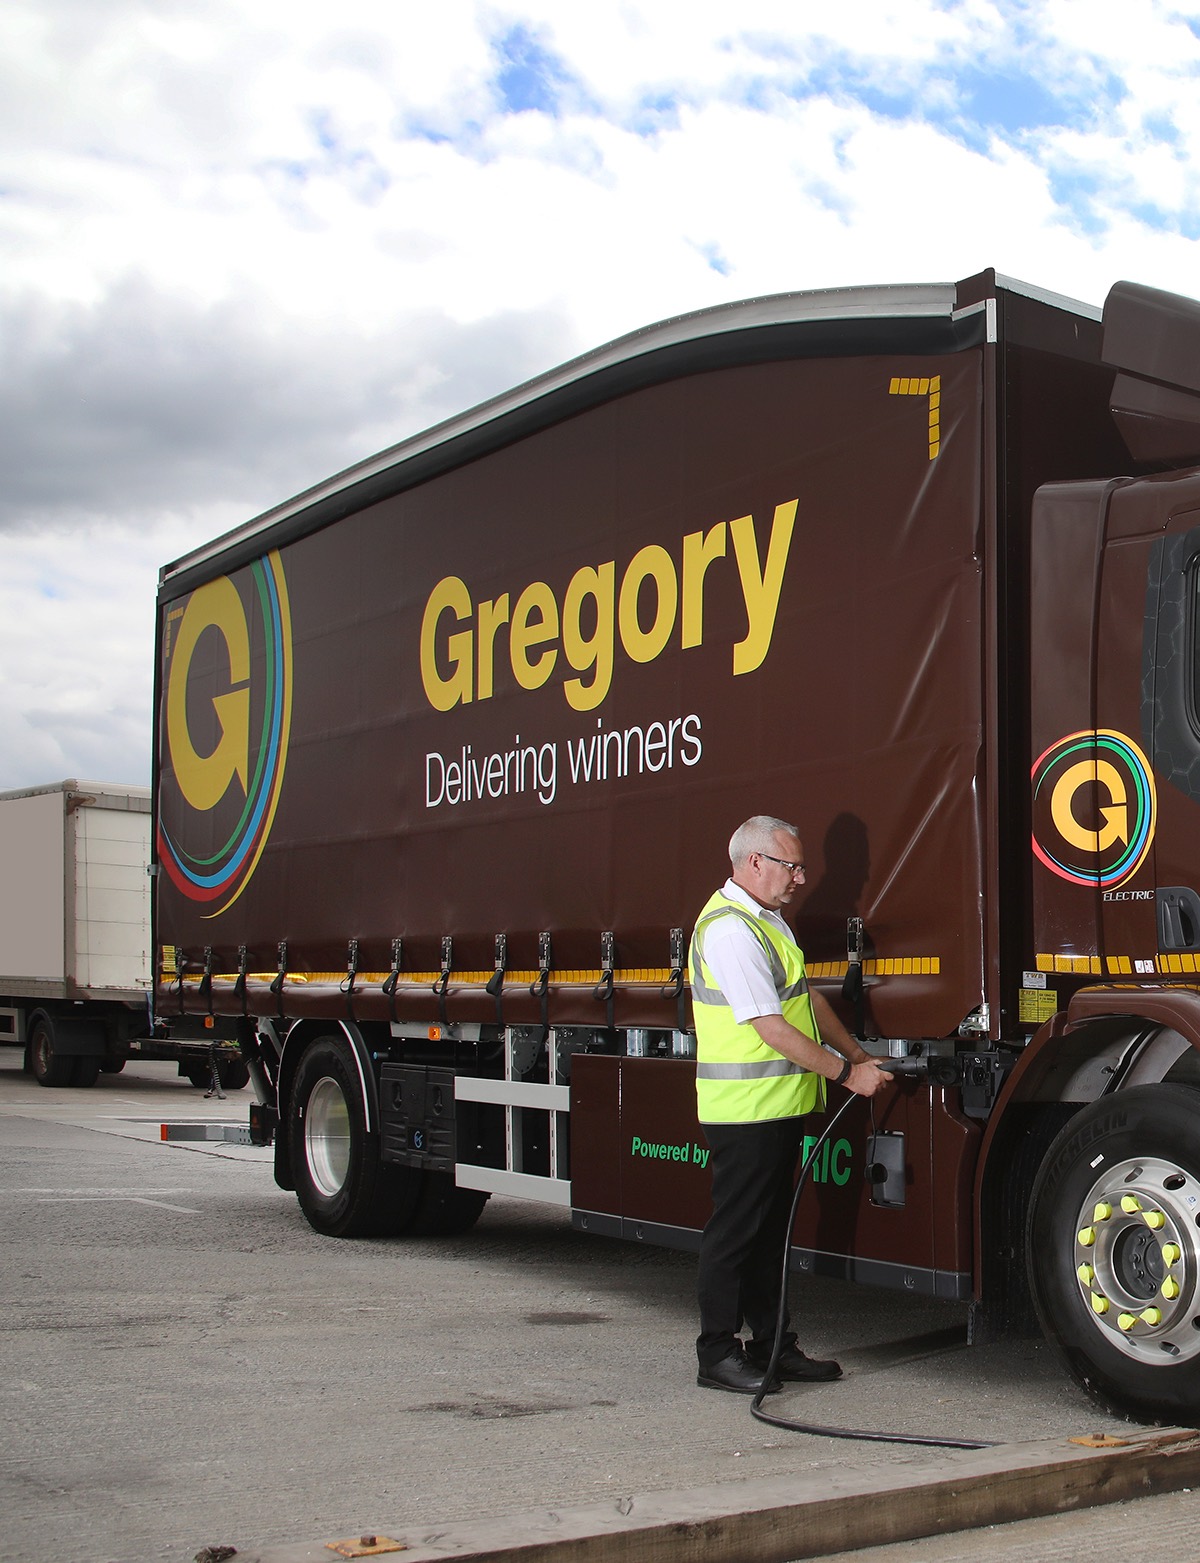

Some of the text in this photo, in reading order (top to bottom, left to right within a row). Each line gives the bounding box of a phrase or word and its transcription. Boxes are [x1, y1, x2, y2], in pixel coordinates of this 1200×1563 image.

[420, 498, 799, 711] Gregory
[425, 714, 702, 807] Delivering winners
[1103, 891, 1154, 901] ELECTRIC
[632, 1136, 710, 1169] Powered by
